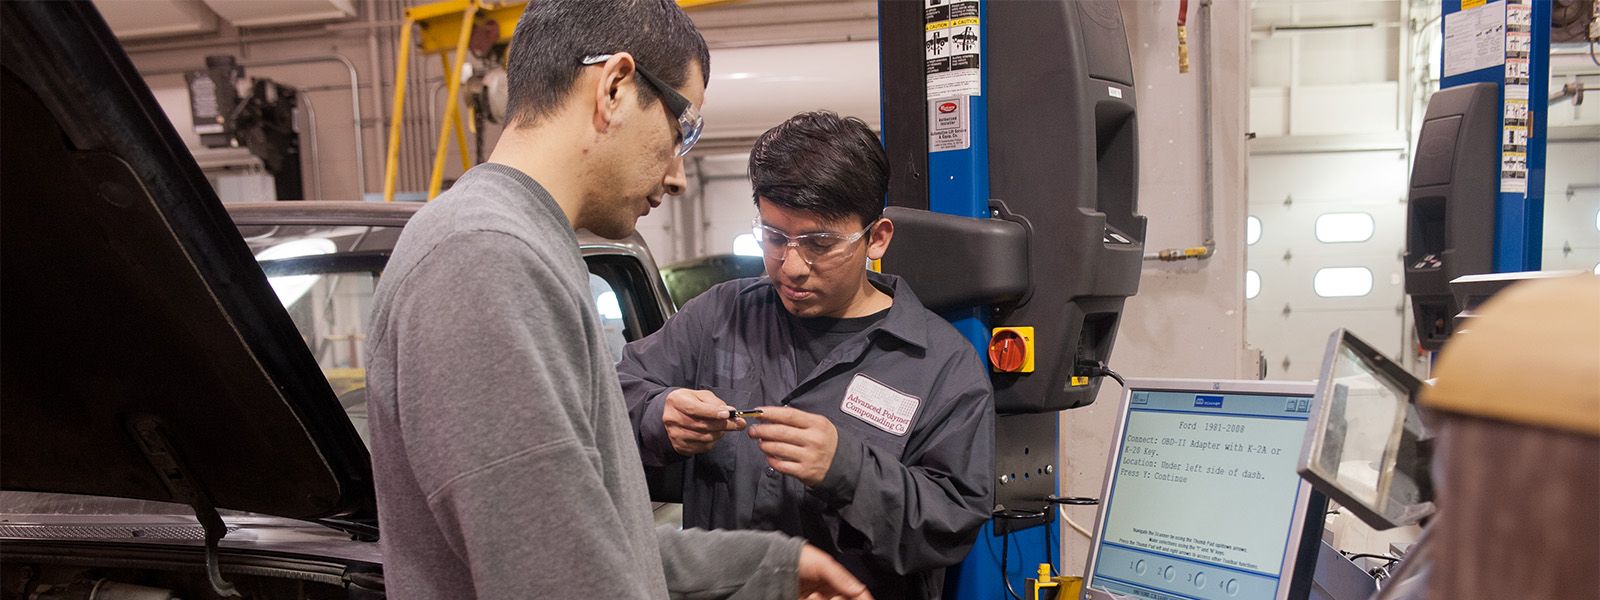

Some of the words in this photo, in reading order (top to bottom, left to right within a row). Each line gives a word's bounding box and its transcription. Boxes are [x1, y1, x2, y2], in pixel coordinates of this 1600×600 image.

[846, 402, 894, 429] Compounding
[847, 394, 882, 414] Advanced
[882, 410, 910, 424] Polymer
[1179, 421, 1196, 430] Ford
[1204, 422, 1246, 433] 1981-2008
[1126, 434, 1158, 445] Connect:
[1161, 437, 1186, 448] OBD-II
[1190, 440, 1220, 451] Adapter
[1225, 443, 1243, 452] with
[1248, 445, 1267, 454] K-2A
[1144, 447, 1159, 457] Key.
[1120, 468, 1138, 477] Press
[1141, 470, 1151, 479] Y:
[1154, 472, 1188, 483] Continue
[1122, 457, 1157, 468] Location:
[1161, 460, 1181, 471] Under
[1185, 463, 1202, 474] left
[1206, 465, 1224, 476] side
[1228, 467, 1238, 477] of
[1242, 469, 1266, 480] dash.
[1130, 561, 1133, 569] 1
[1158, 567, 1162, 575] 2
[1187, 574, 1192, 582] 3
